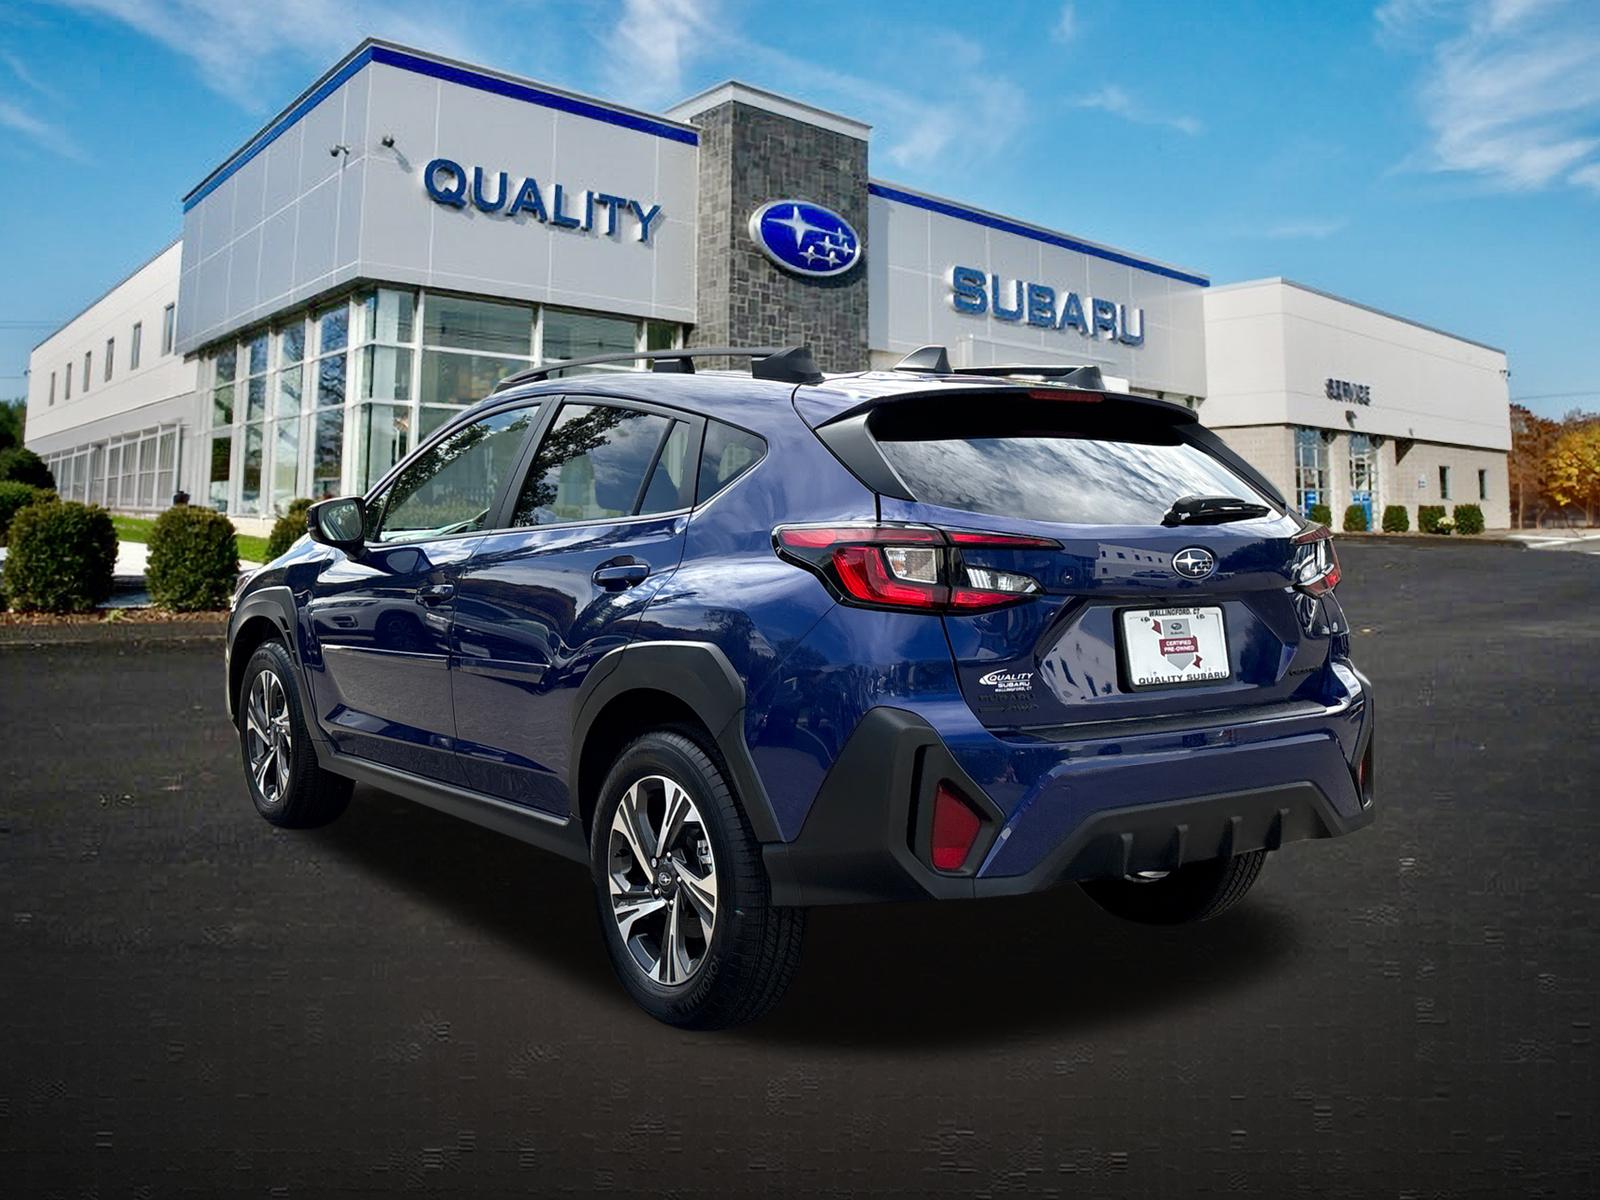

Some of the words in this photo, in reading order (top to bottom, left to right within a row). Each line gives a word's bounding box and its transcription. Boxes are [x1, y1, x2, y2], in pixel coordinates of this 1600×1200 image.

[424, 158, 661, 243] QUALITY
[950, 264, 1145, 347] SUBARU
[1324, 378, 1371, 407] SERVICE
[1163, 645, 1195, 653] PRE-OWNED
[988, 672, 1034, 682] QUALITY
[1138, 675, 1183, 685] QUALITY
[1186, 671, 1227, 681] SUBARU
[997, 681, 1031, 689] SUBARU
